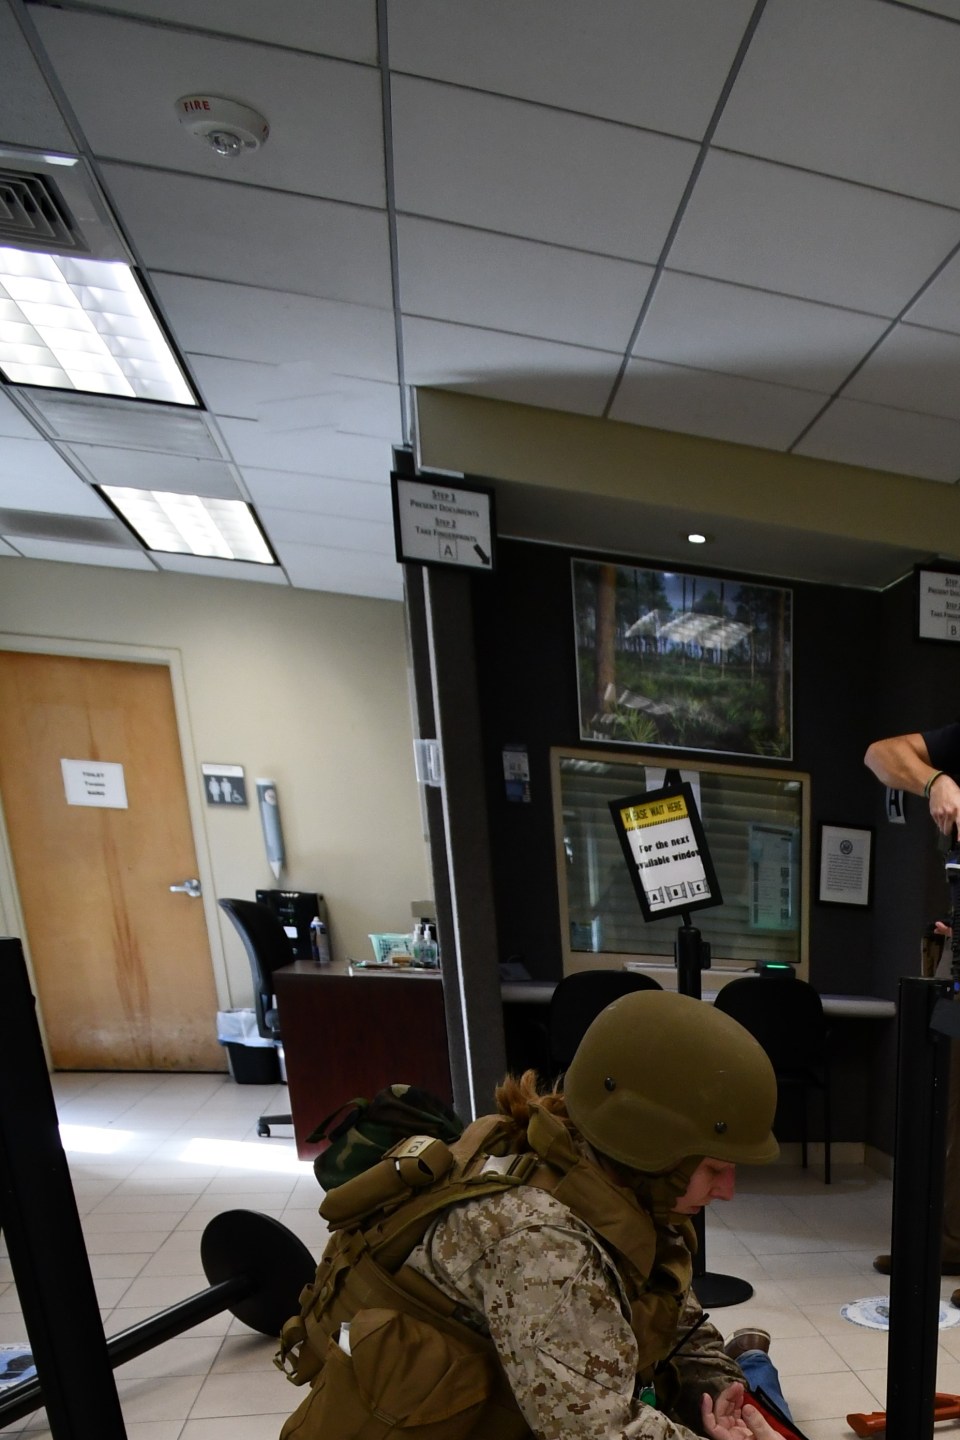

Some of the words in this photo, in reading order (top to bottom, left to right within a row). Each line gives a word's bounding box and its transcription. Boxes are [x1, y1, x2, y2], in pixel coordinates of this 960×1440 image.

[183, 100, 210, 112] FIRE
[451, 492, 456, 502] 1
[452, 519, 456, 528] 2
[444, 544, 453, 556] A
[950, 624, 957, 636] B
[625, 809, 648, 822] PLEASE
[649, 804, 665, 816] WAIT
[666, 801, 683, 813] HERE
[639, 844, 652, 853] For
[655, 840, 669, 850] the
[671, 835, 690, 846] next
[673, 888, 679, 896] B
